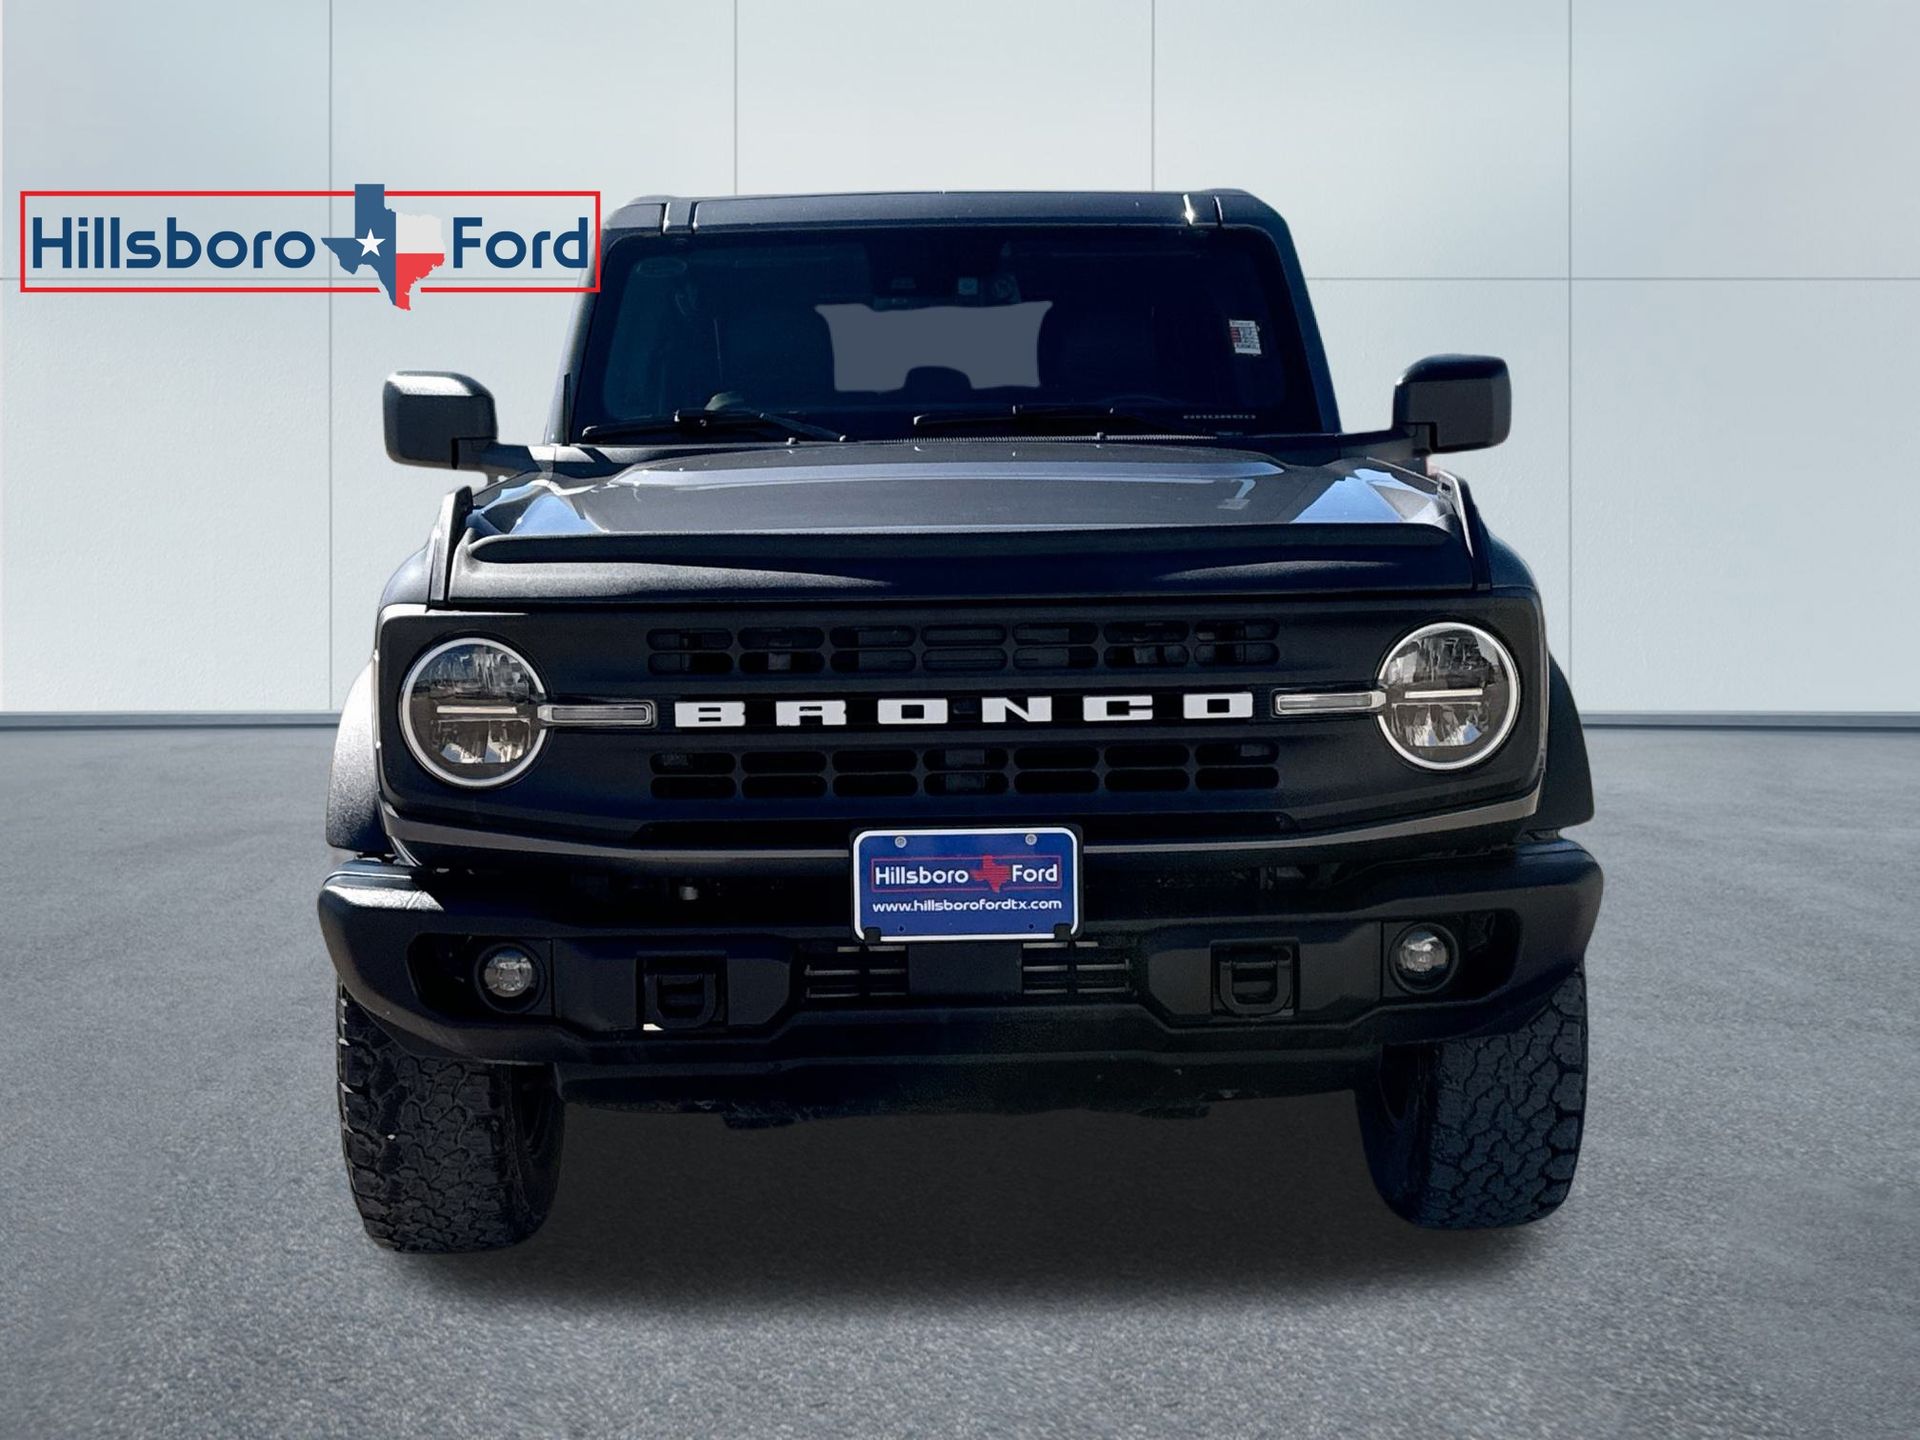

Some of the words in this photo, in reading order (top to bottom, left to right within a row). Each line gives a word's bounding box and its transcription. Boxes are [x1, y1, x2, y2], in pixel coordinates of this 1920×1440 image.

[674, 693, 1253, 727] BRONCO
[874, 866, 969, 885] Hillsboro
[1011, 865, 1058, 882] Ford
[872, 898, 1062, 912] www.hillsborofordtx.com
